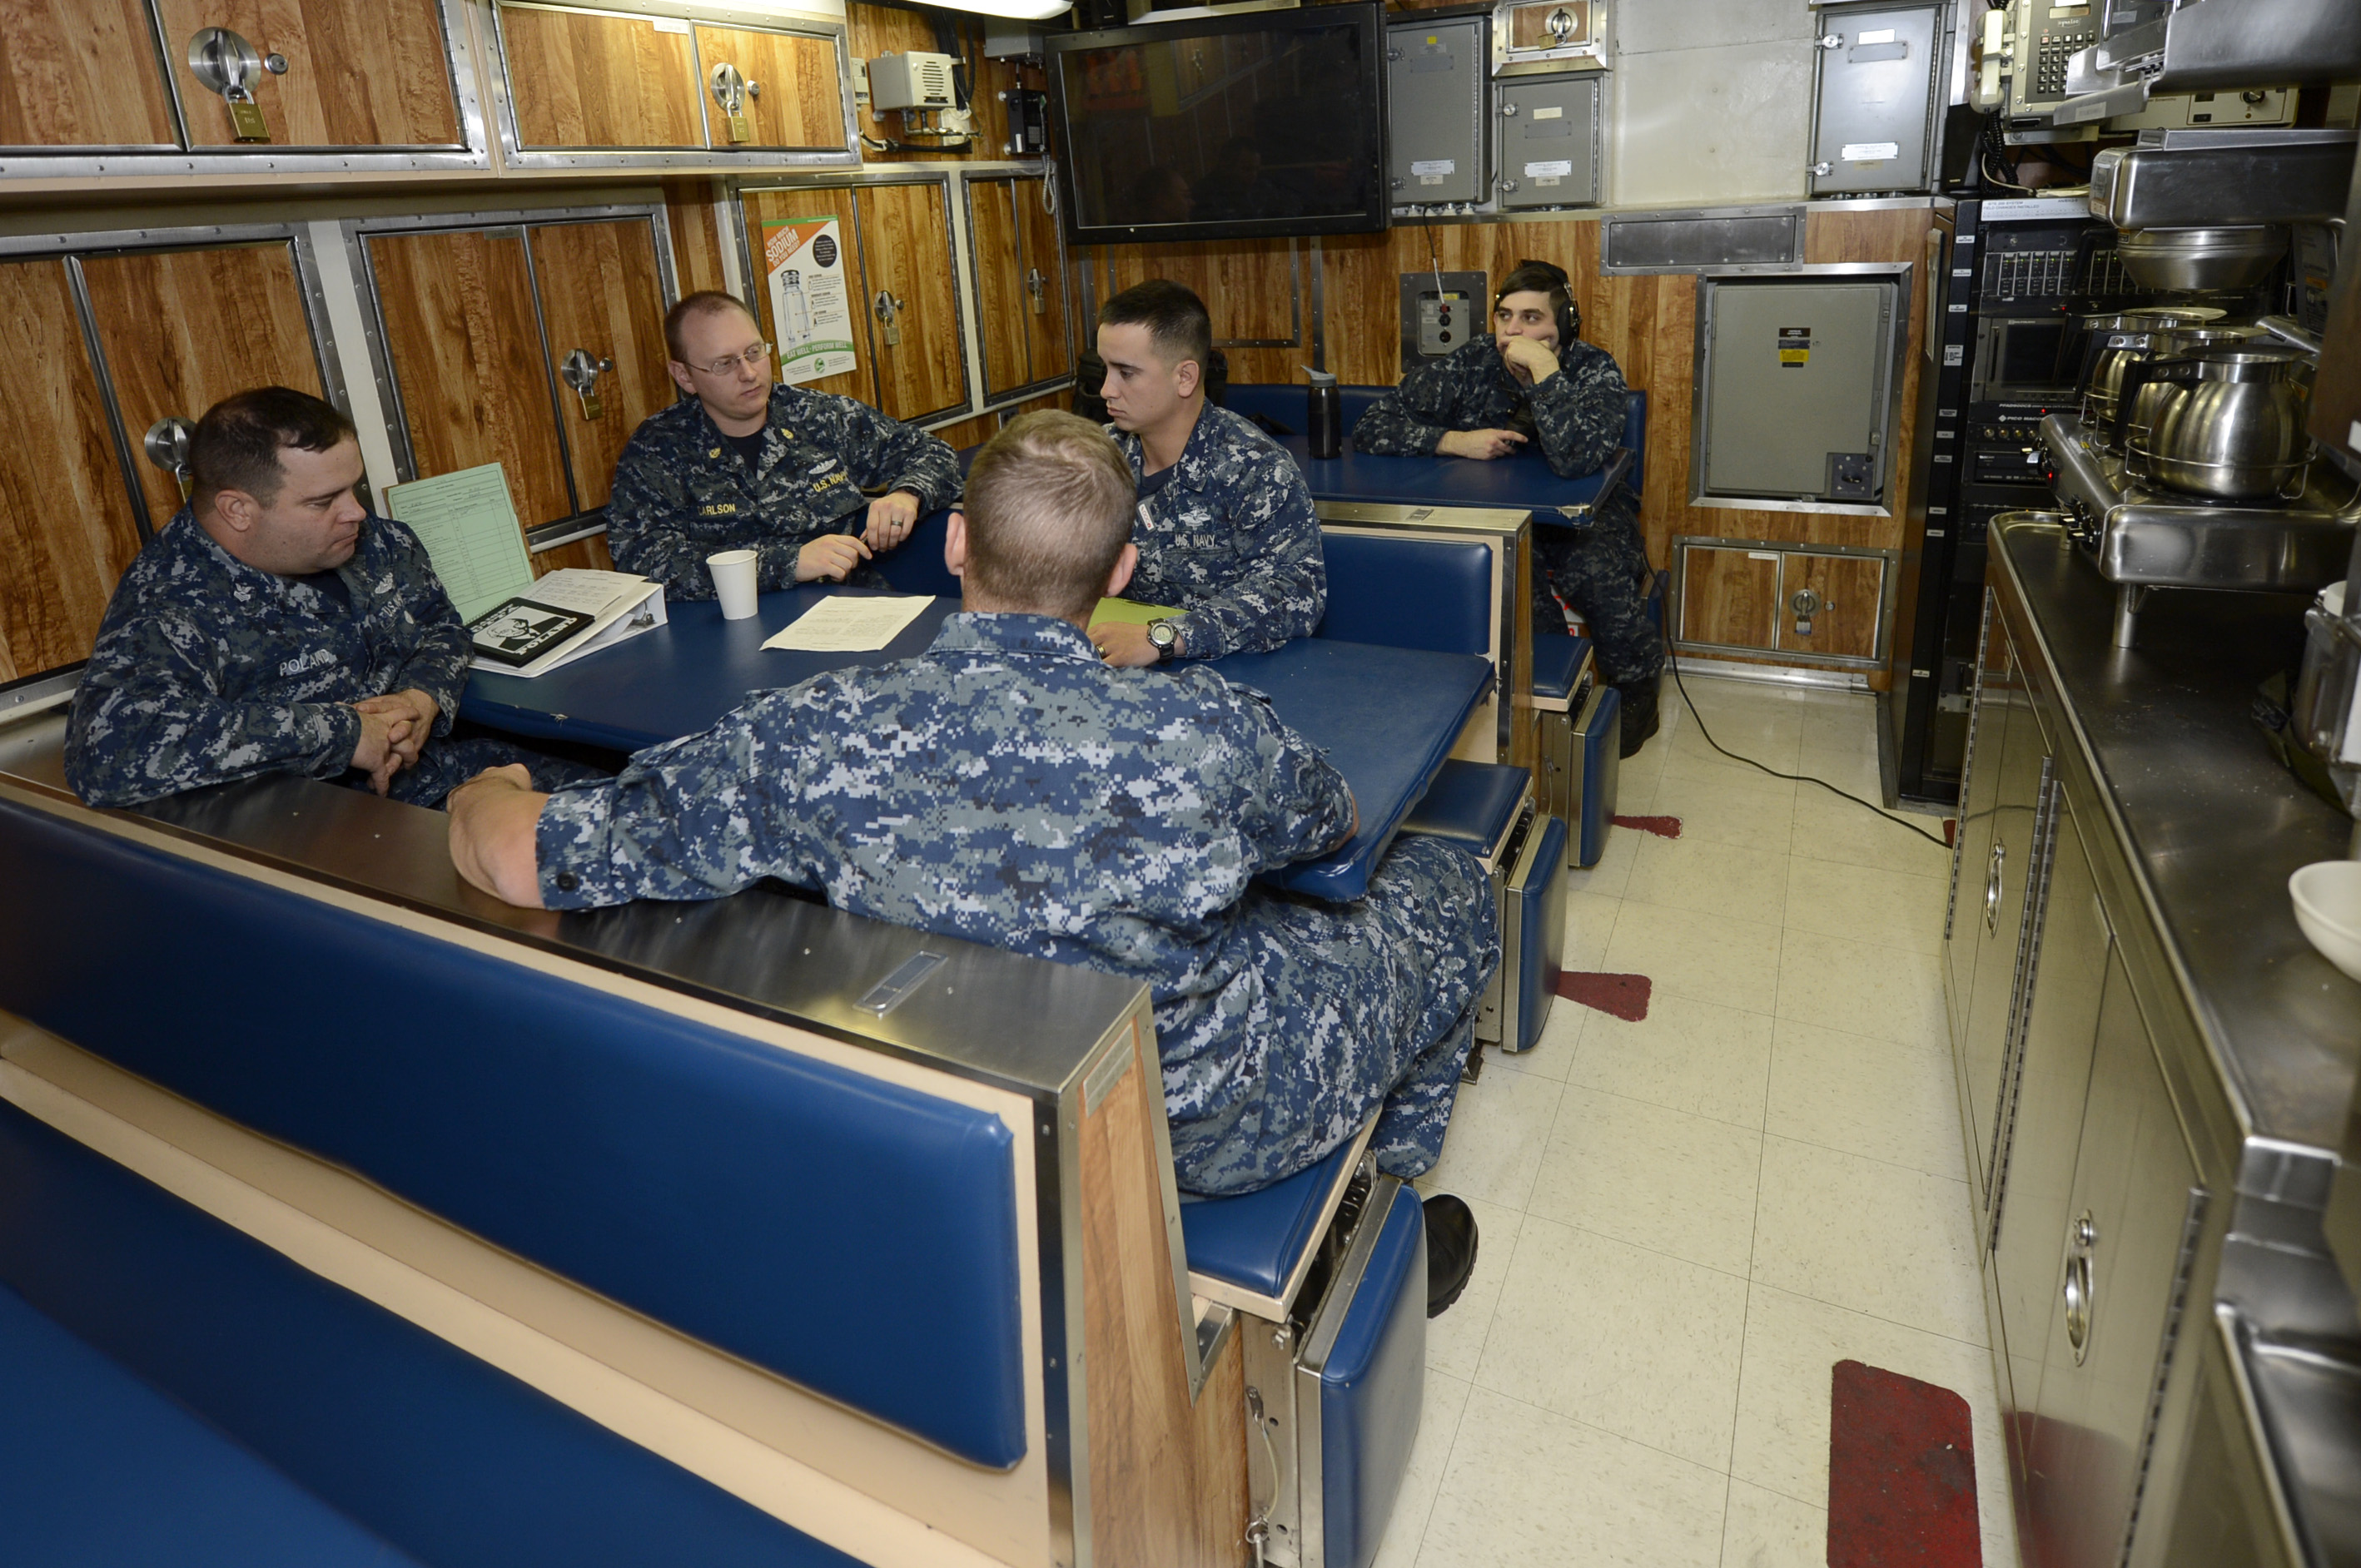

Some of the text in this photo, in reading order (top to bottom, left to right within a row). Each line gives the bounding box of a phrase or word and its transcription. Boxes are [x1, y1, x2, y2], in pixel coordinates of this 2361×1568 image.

[766, 228, 798, 262] SODIUM
[767, 226, 790, 248] HOW MUCH
[773, 258, 780, 267] DO
[779, 251, 788, 261] YOU
[788, 240, 801, 255] NEED?
[786, 340, 847, 360] EAT WELL PERFORM WELL
[813, 479, 828, 493] U.S.
[698, 503, 736, 516] CARLSON
[1175, 533, 1215, 547] U.S. NAVY
[513, 616, 578, 656] POLAND
[280, 648, 330, 677] POLAND
